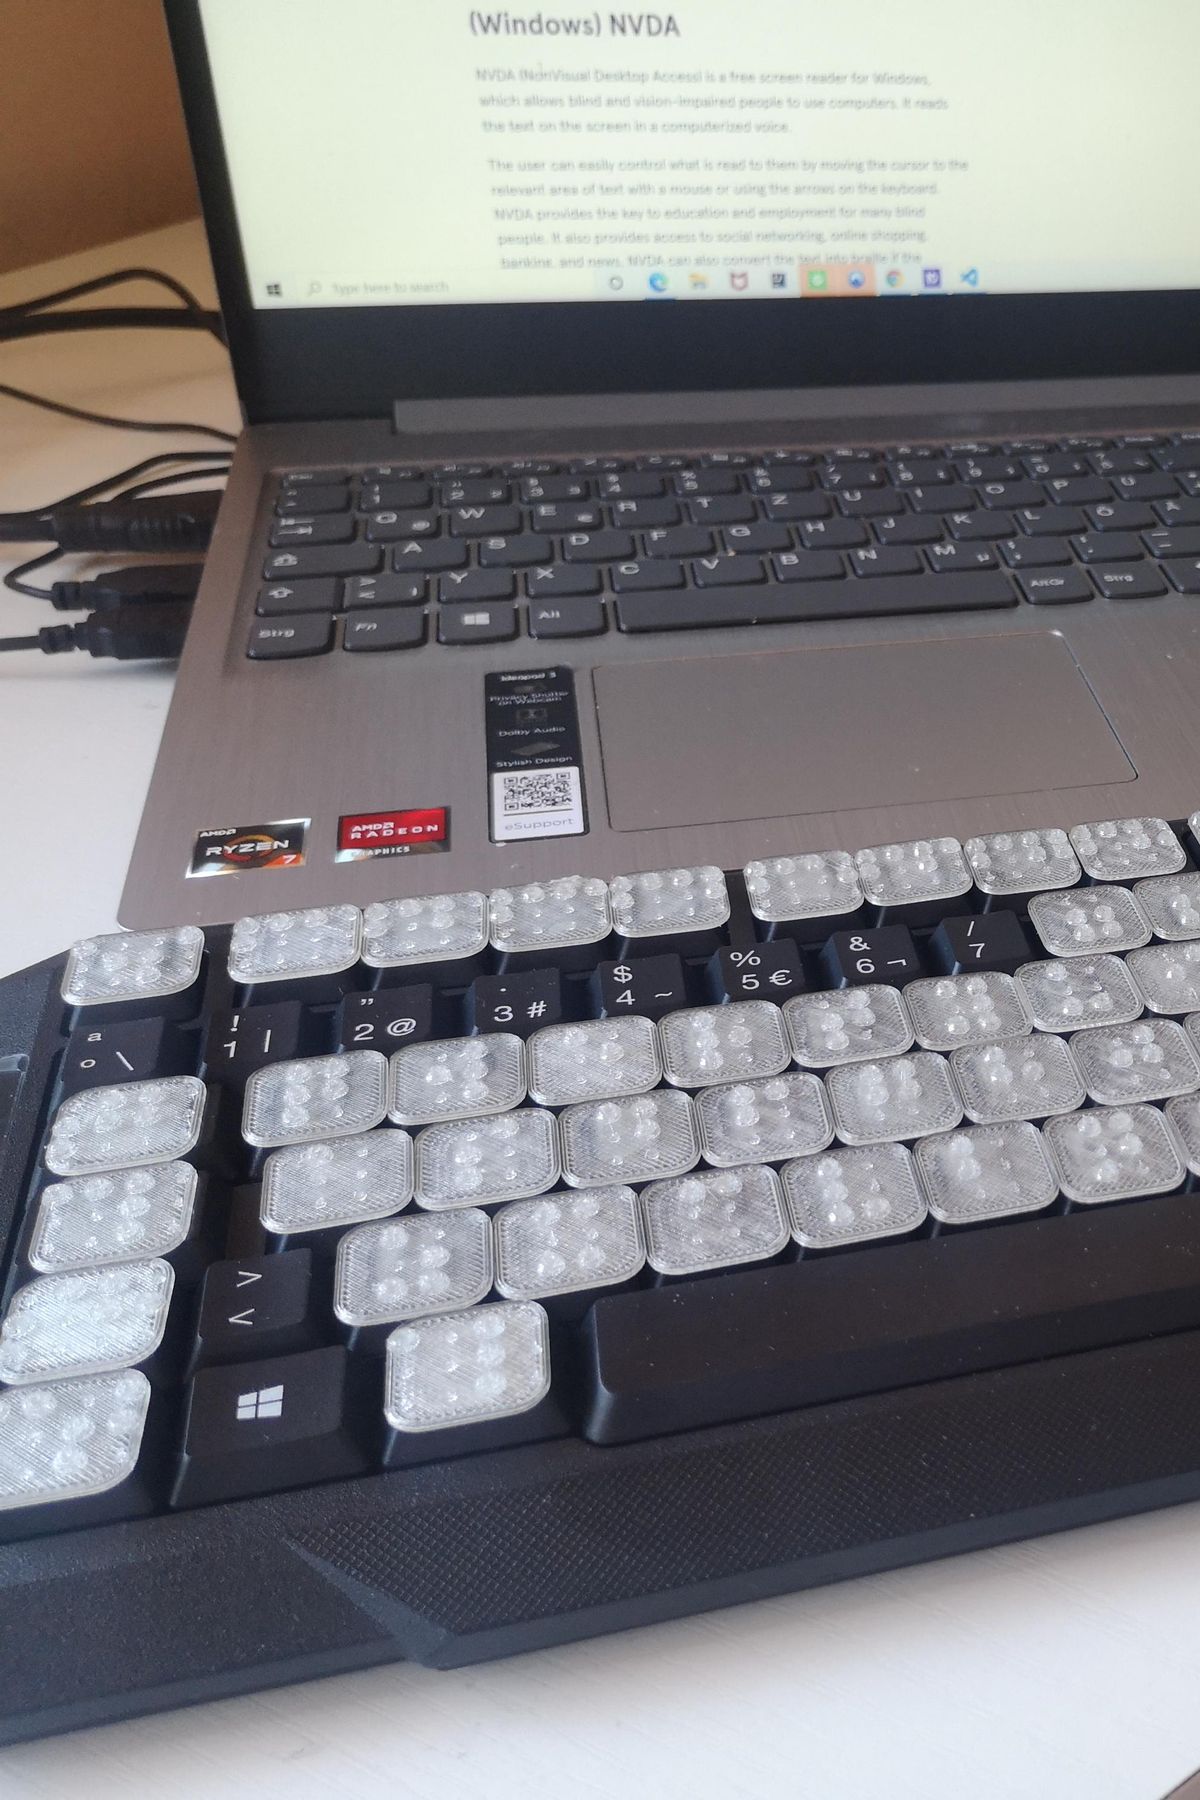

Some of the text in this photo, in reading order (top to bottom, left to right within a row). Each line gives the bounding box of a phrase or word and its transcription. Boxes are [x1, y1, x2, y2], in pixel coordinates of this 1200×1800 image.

[470, 10, 681, 37] (Windows) NVDA
[499, 726, 565, 737] Dolby Audio
[496, 756, 573, 768] Stylish Design
[350, 824, 438, 840] RADEON
[352, 822, 394, 832] AMD
[505, 818, 573, 831] eSupport
[200, 828, 236, 837] AMD
[205, 840, 290, 857] RYZEN
[352, 846, 410, 857] APHICS
[282, 854, 297, 864] 7
[849, 936, 871, 951] &
[968, 943, 985, 958] 7
[730, 950, 761, 968] %
[856, 958, 875, 974] 6
[613, 965, 633, 983] $
[742, 969, 793, 990] 5 €
[615, 990, 636, 1005] 4
[494, 1000, 547, 1022] 3 #
[353, 1018, 417, 1041] 2 @
[223, 1041, 237, 1058] 1
